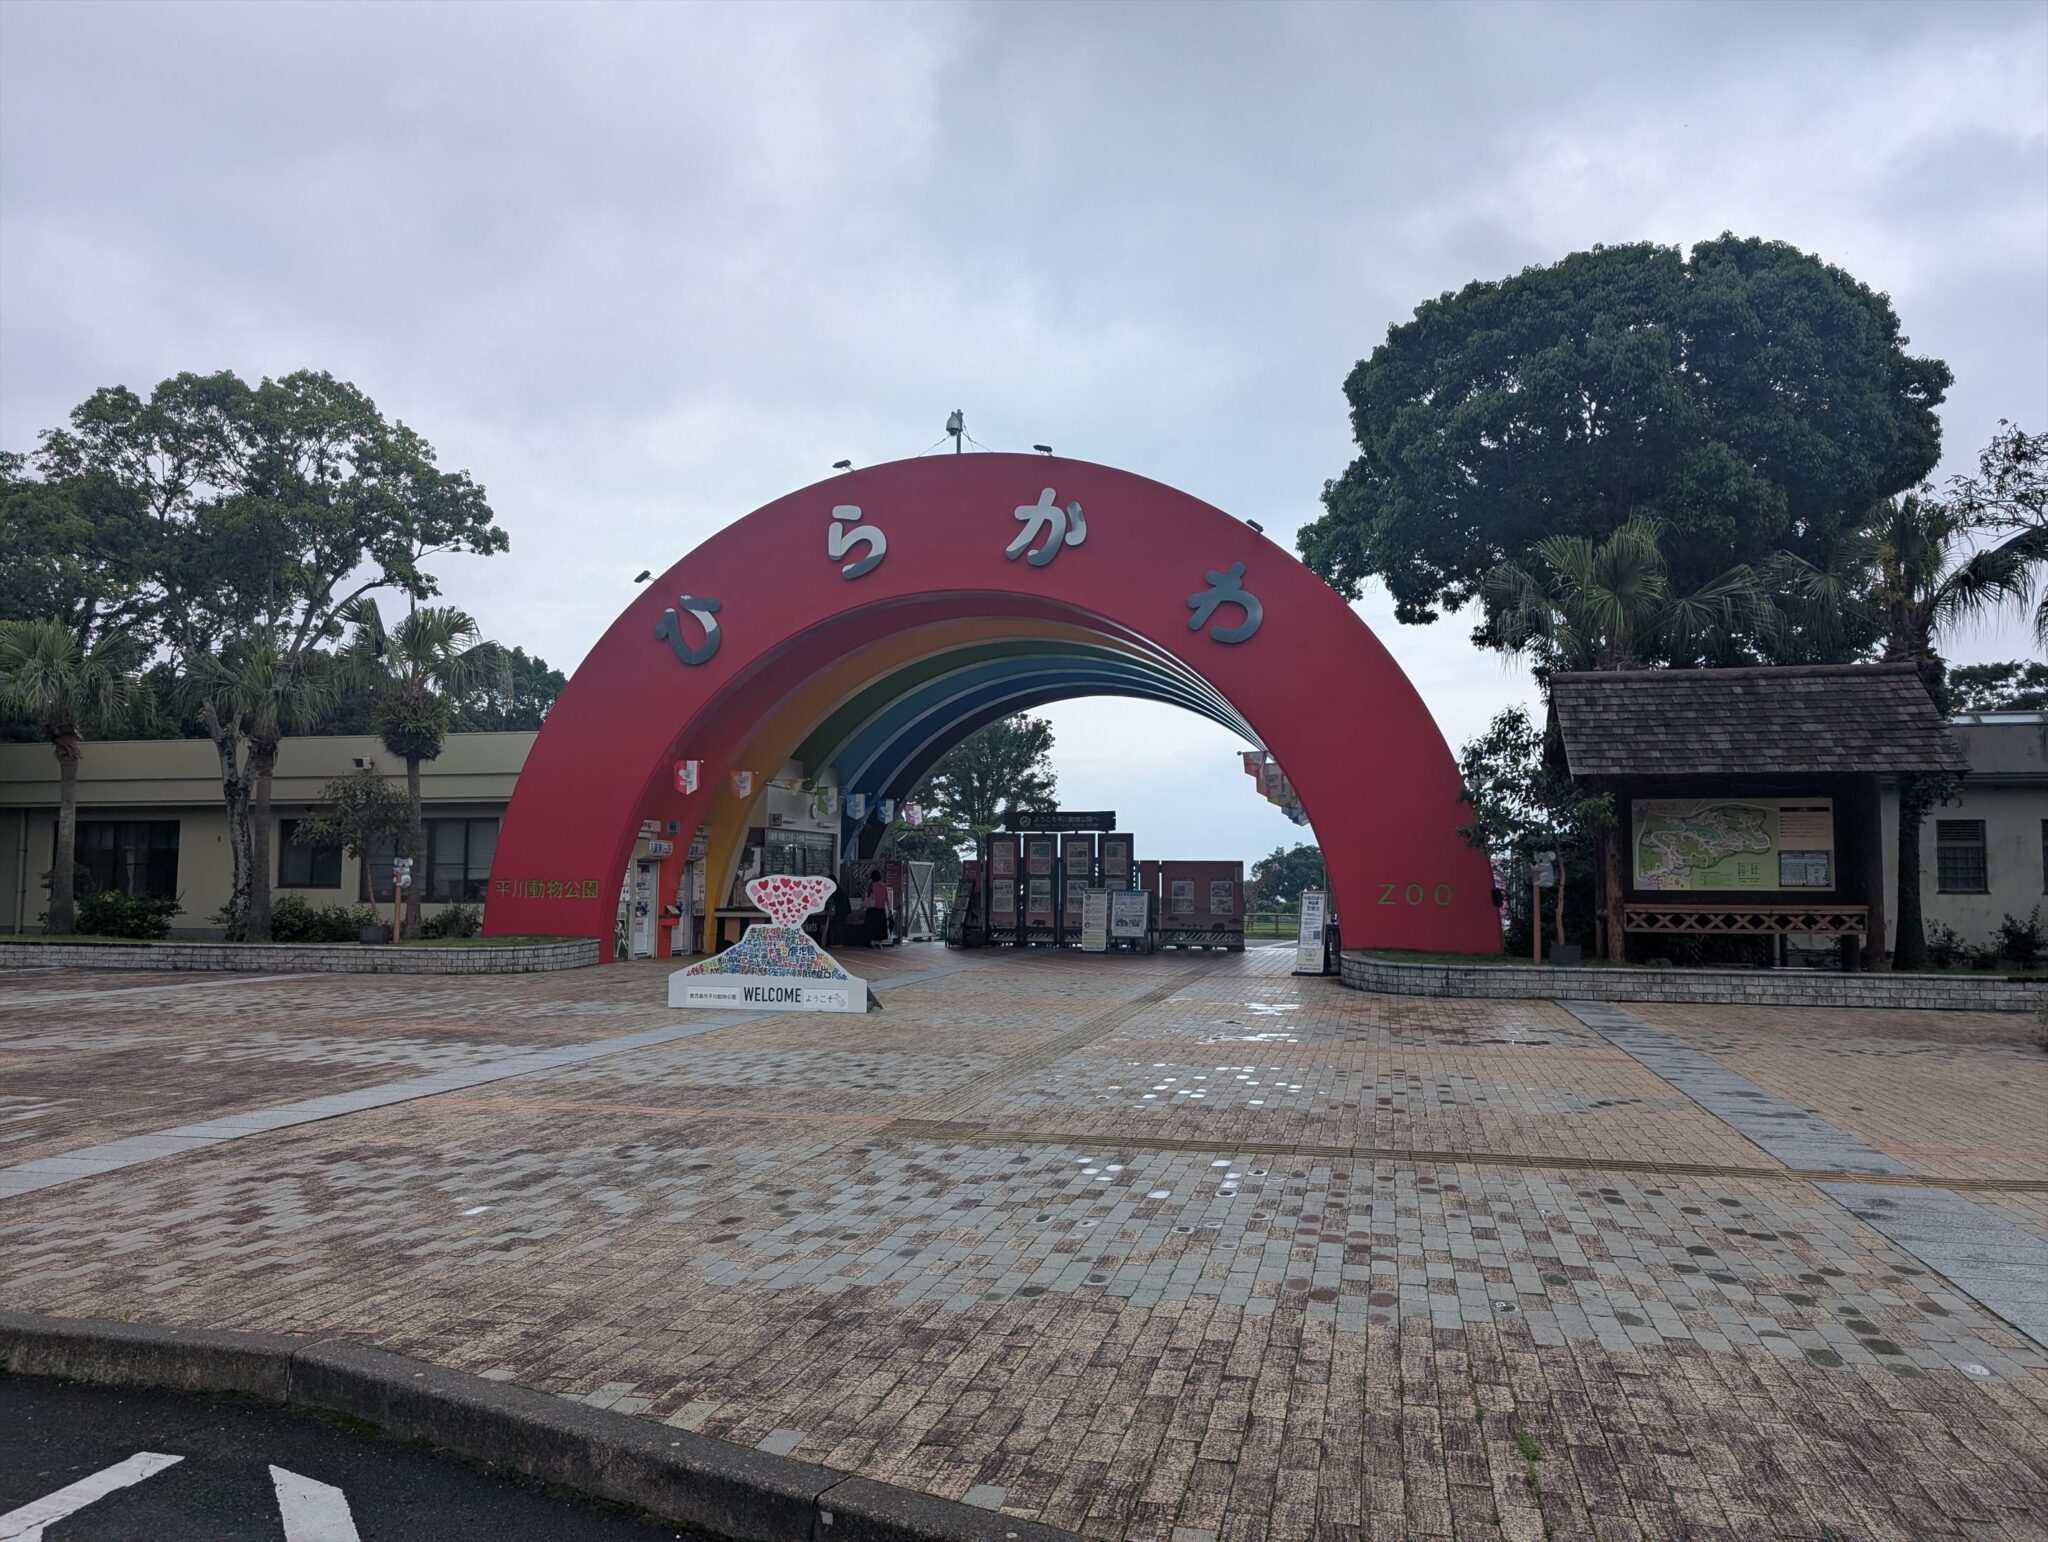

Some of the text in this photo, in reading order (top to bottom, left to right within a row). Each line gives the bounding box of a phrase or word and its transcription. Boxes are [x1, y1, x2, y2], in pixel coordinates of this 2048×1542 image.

[655, 487, 1263, 665] ひらかわ
[495, 879, 599, 898] 平川動物公園
[1378, 883, 1453, 905] ZOO
[743, 987, 802, 1003] WELCOME
[805, 994, 833, 1003] ようこそ
